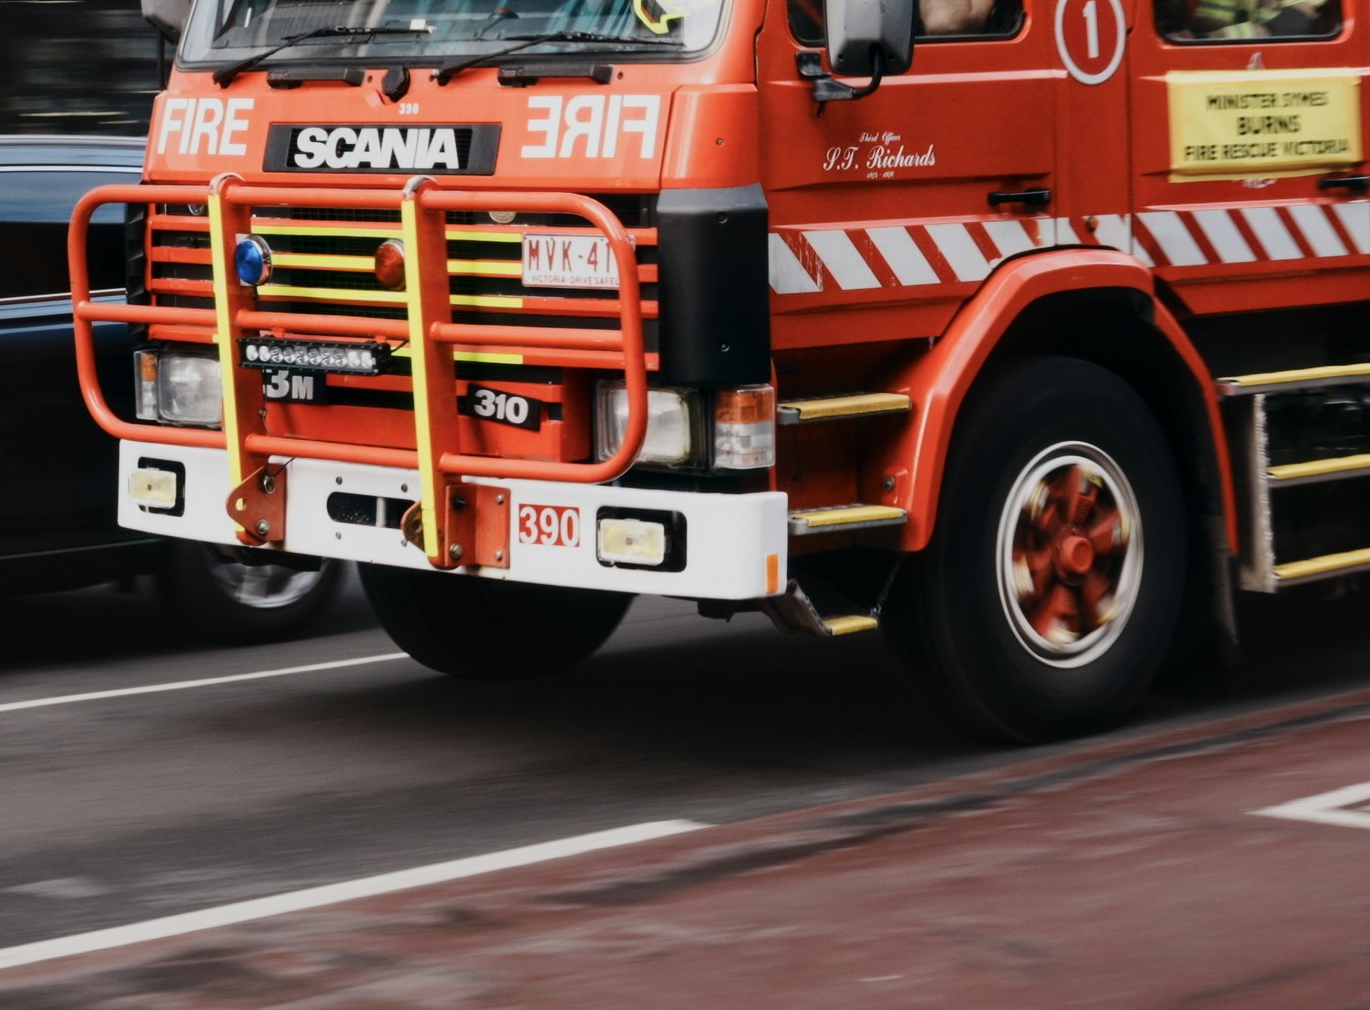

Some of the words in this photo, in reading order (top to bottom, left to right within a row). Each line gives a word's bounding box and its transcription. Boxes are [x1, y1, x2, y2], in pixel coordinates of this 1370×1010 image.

[1082, 0, 1100, 59] 1
[398, 103, 420, 115] 390
[1206, 93, 1277, 110] MINISTER
[157, 98, 255, 156] FIRE
[1237, 115, 1301, 136] BURNS
[294, 127, 459, 169] SCANIA
[866, 143, 936, 169] Richards
[1185, 145, 1218, 161] FIRE
[1222, 142, 1278, 160] RESCUE
[1282, 139, 1351, 157] VICTORIA
[474, 390, 529, 424] 310
[519, 506, 579, 547] 390
